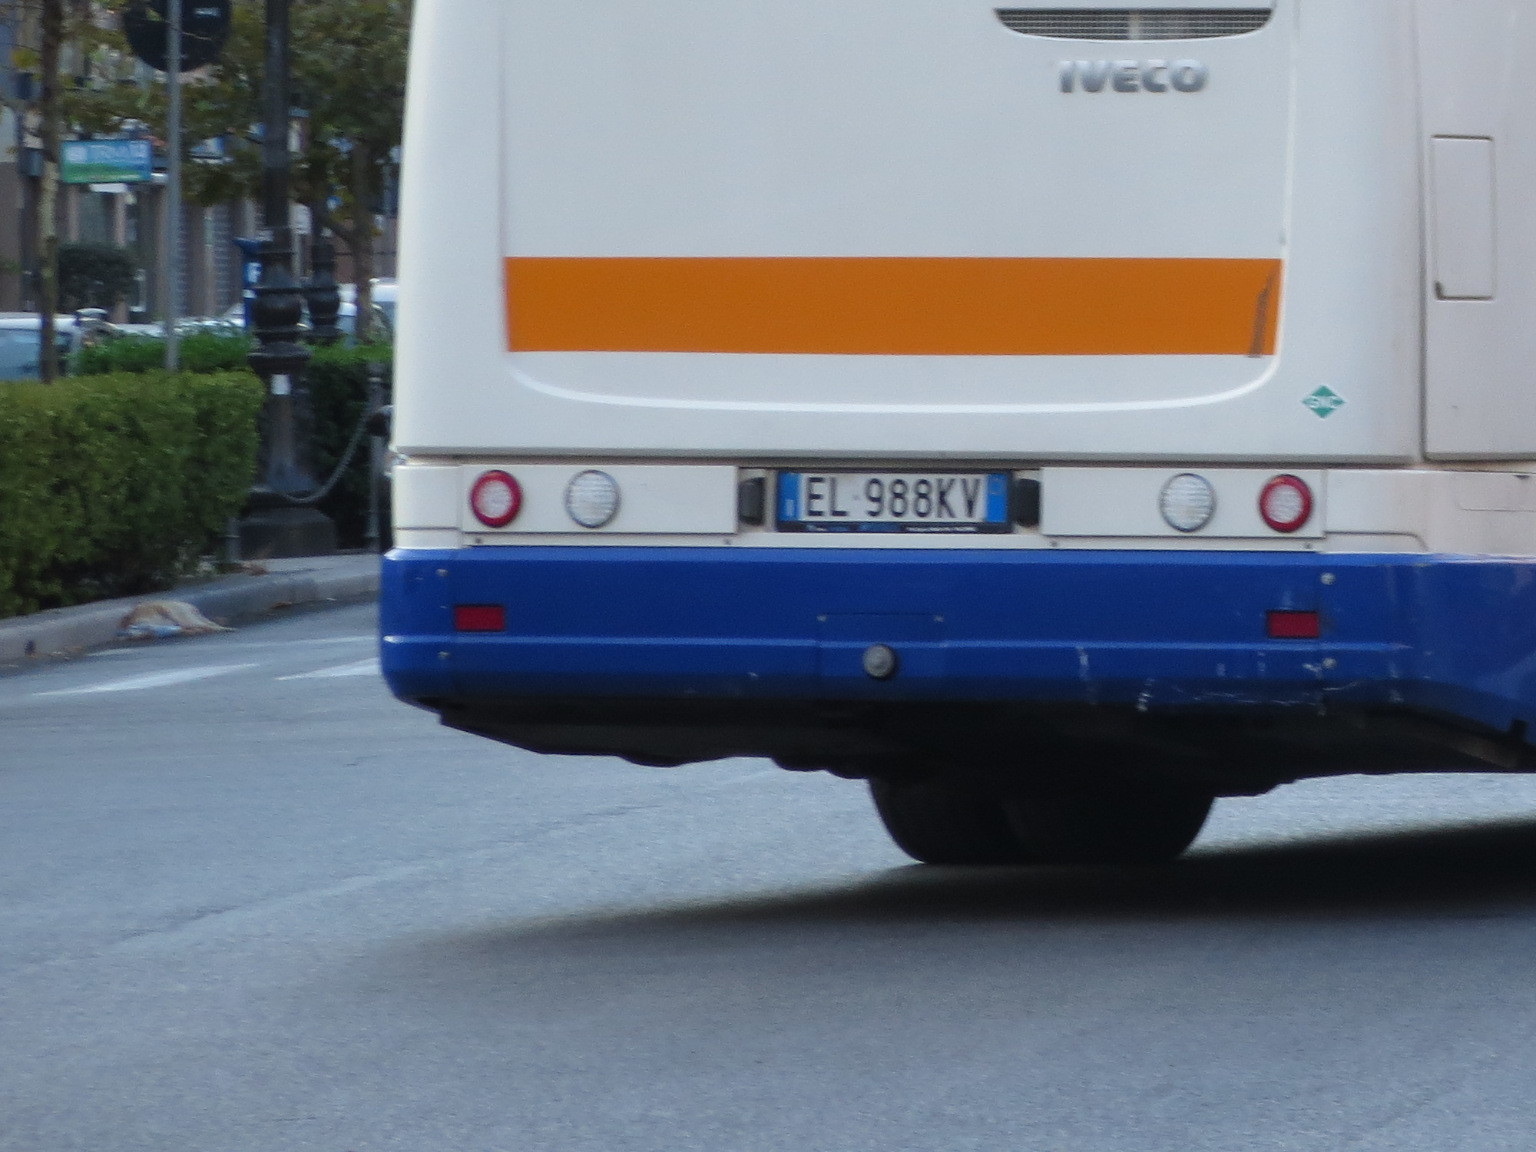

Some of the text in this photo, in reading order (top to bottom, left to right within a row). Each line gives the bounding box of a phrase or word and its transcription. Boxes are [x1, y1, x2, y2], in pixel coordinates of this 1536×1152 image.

[1058, 59, 1209, 94] IVECO
[804, 476, 982, 519] EL 988KV
